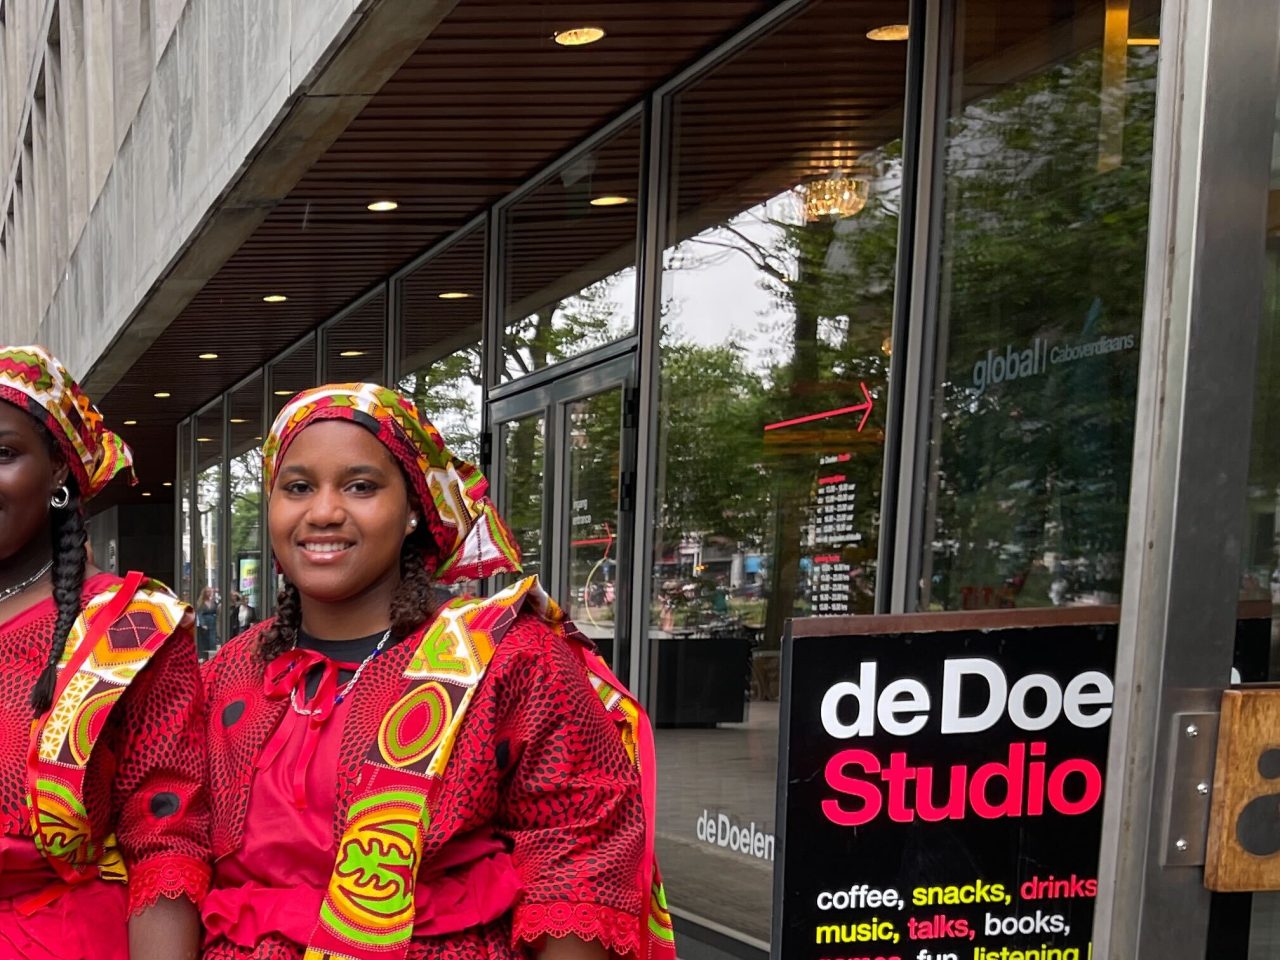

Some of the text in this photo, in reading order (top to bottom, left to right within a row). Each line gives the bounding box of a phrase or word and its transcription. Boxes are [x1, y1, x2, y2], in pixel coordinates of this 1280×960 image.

[973, 338, 1041, 396] global
[821, 657, 1114, 738] de Doe
[821, 742, 1102, 826] Studio
[817, 885, 904, 910] coffee,
[913, 880, 1011, 905] snacks,
[816, 910, 1070, 943] music, talks, books,
